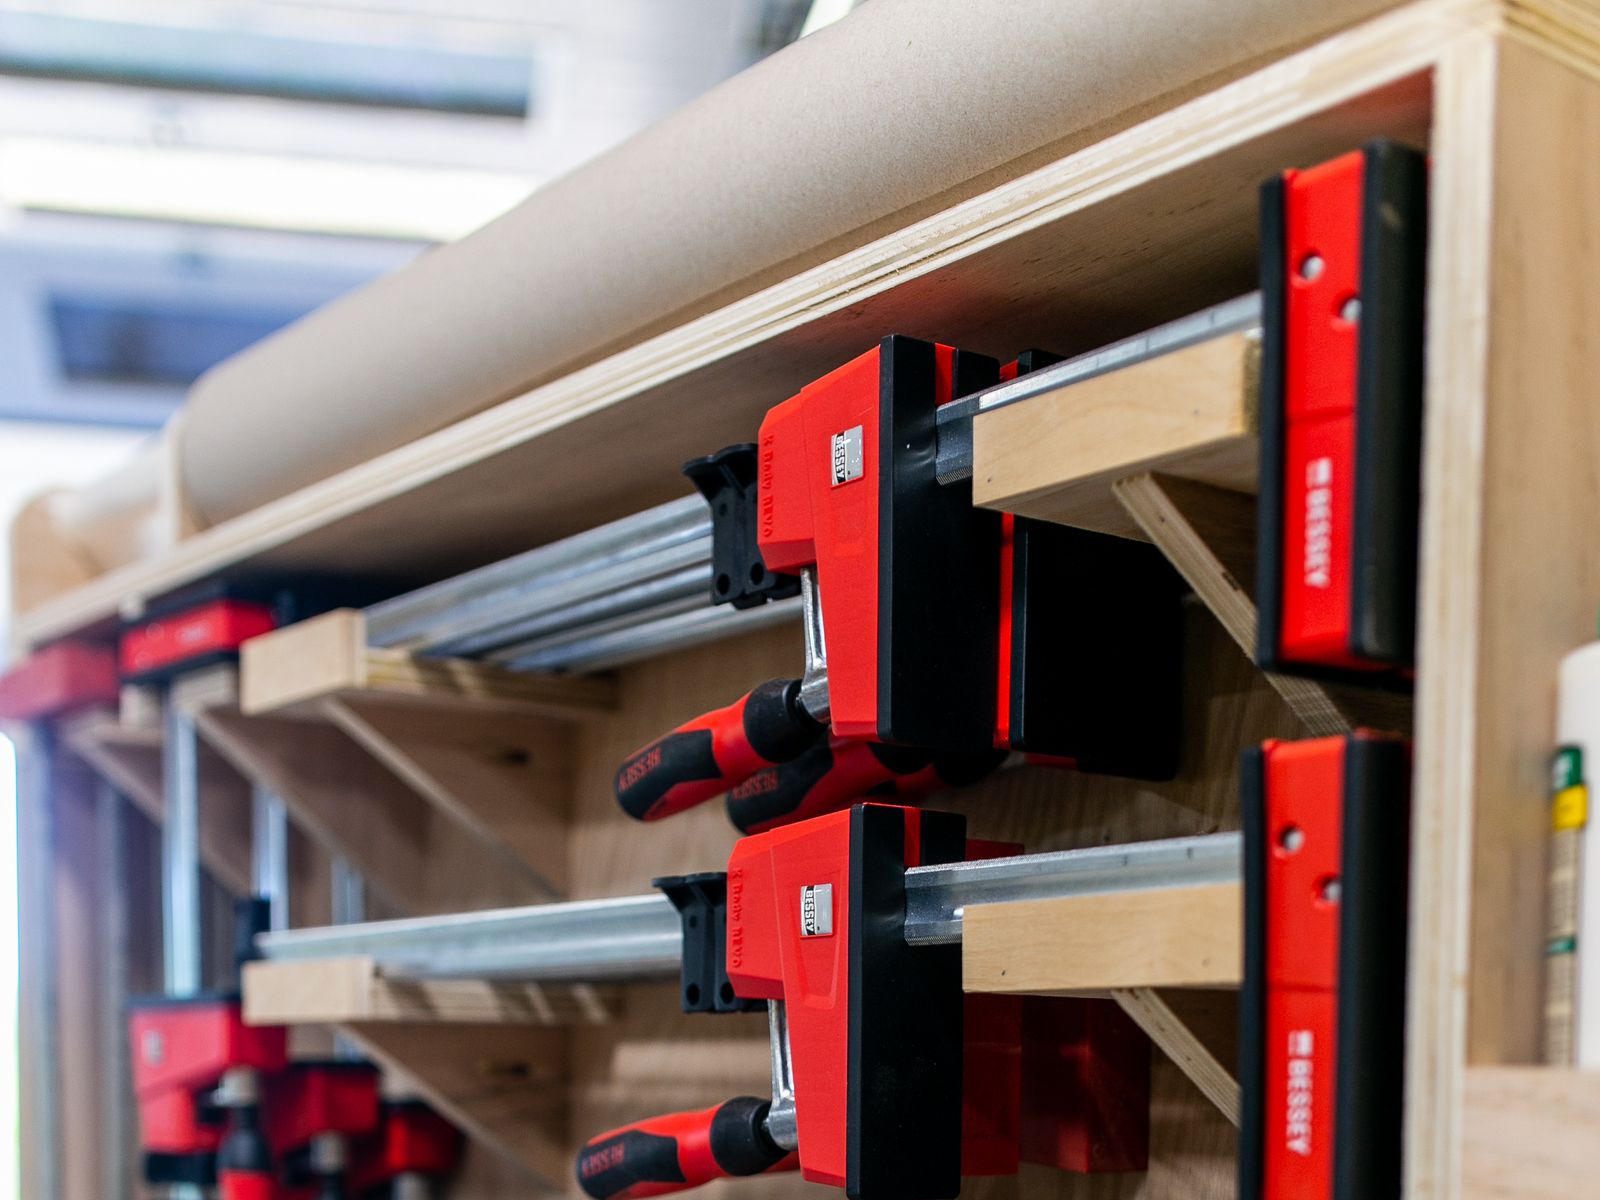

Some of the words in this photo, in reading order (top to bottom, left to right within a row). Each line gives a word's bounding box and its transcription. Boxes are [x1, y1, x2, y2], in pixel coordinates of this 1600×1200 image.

[834, 435, 845, 479] BESSEY
[804, 889, 815, 935] BESSEY
[1286, 1058, 1314, 1156] BESSEY
